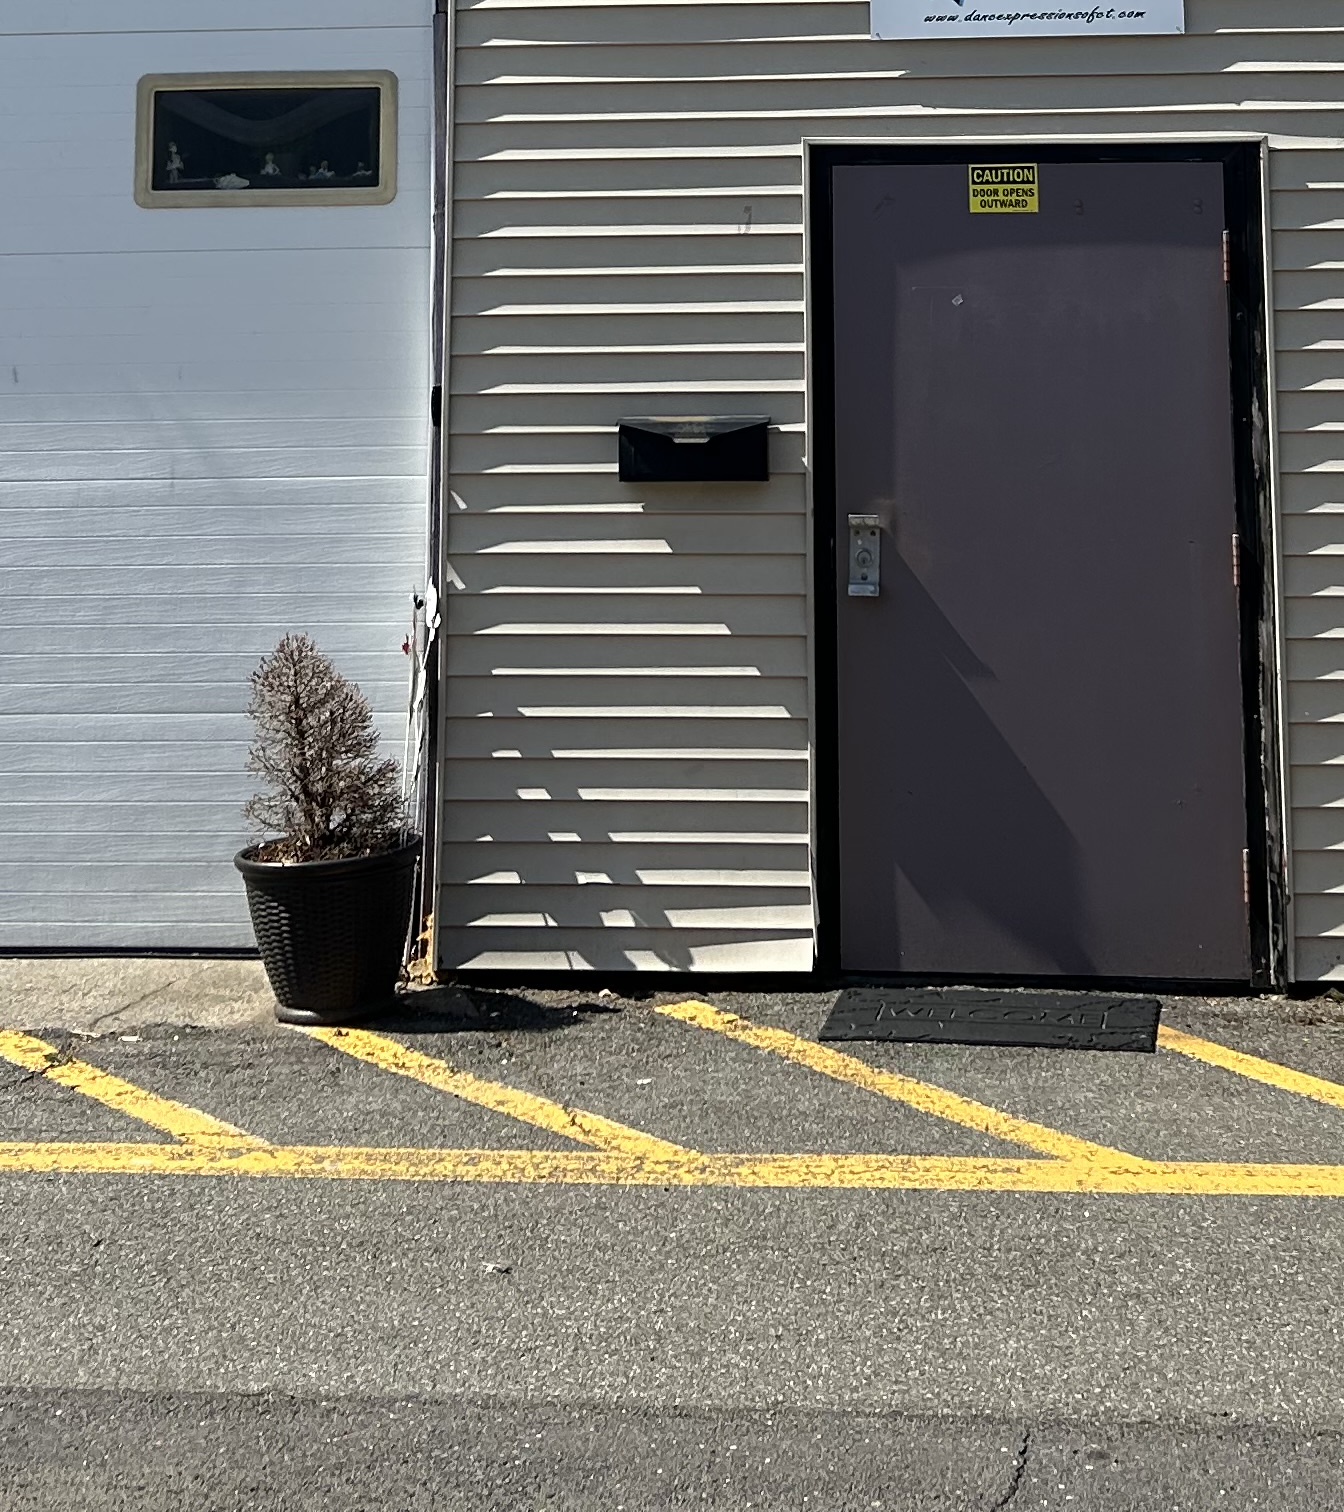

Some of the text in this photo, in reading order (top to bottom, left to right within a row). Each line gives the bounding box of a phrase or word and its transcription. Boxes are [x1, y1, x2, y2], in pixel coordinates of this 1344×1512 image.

[923, 5, 1147, 25] www.dancexpressionsofct.com
[973, 168, 1034, 183] CAUTION
[972, 188, 1035, 198] DOOR OPENS
[980, 199, 1028, 208] OUTWARD
